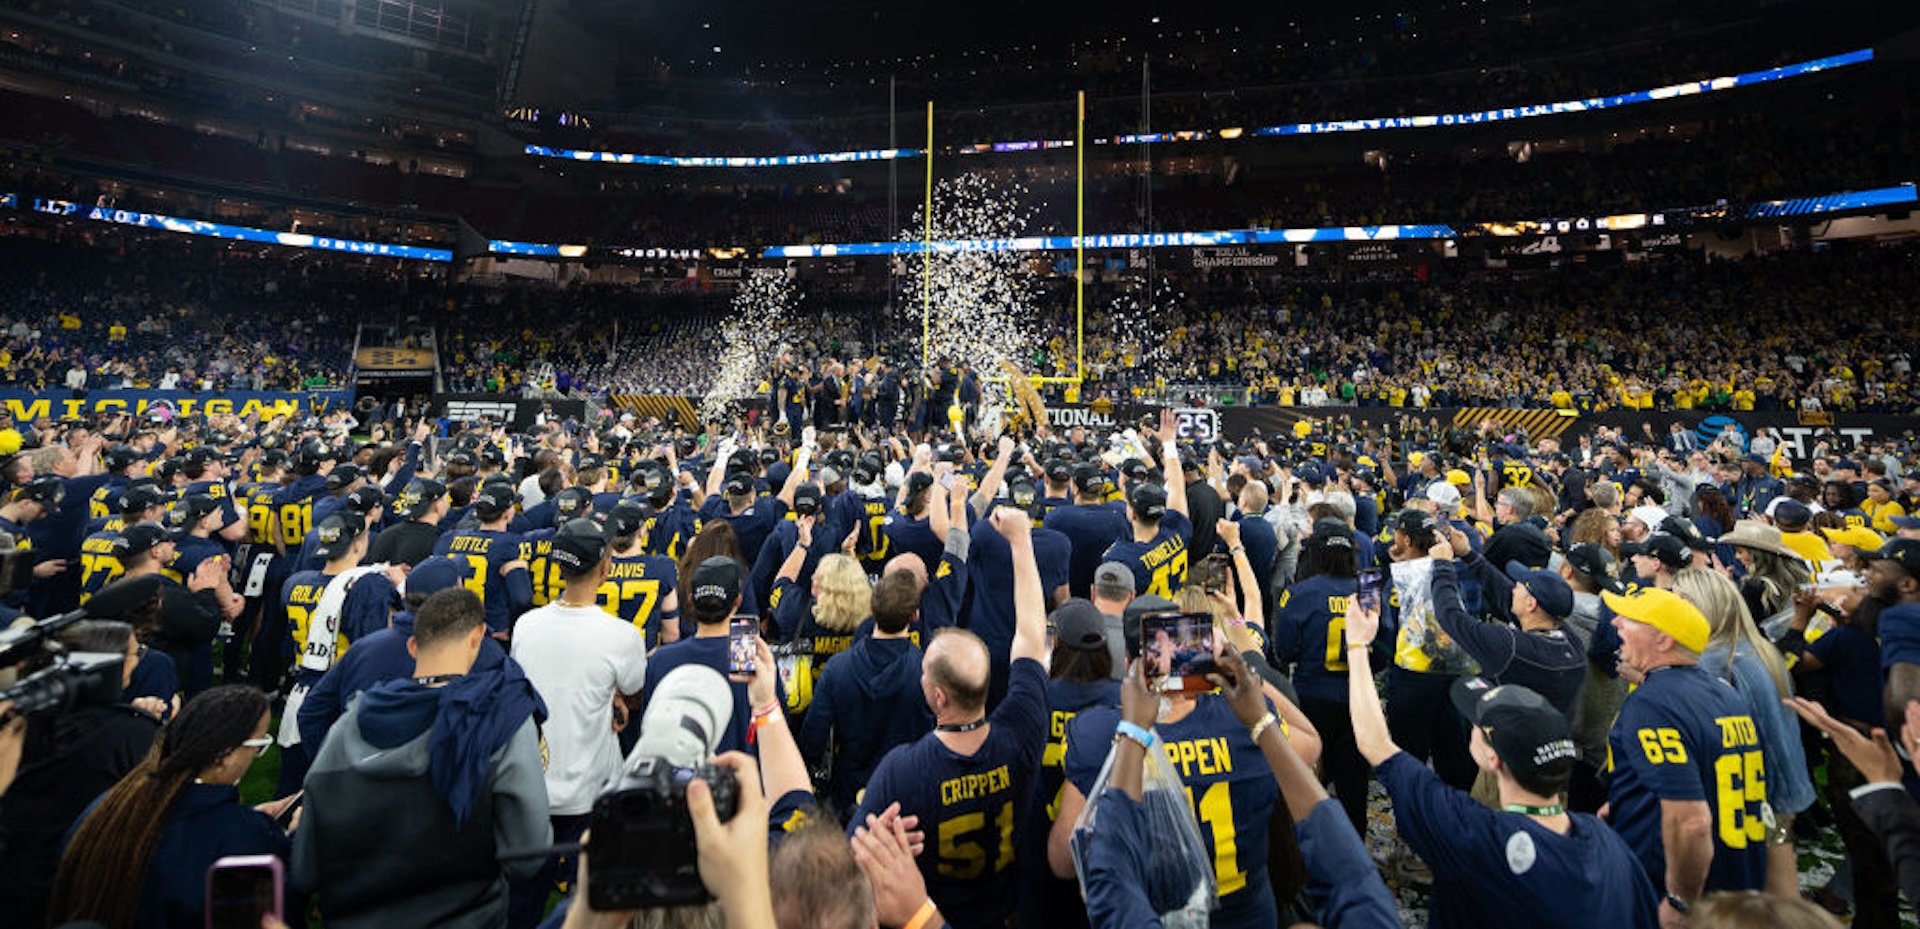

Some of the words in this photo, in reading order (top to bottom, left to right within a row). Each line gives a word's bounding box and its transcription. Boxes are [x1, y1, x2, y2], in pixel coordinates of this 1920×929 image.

[1298, 117, 1411, 133] MICGAN
[1424, 102, 1577, 127] OLVERINE
[447, 401, 517, 423] ESPN
[1045, 408, 1117, 427] TIONAL
[1178, 414, 1210, 437] 25
[1767, 426, 1875, 459] ATT
[209, 484, 226, 498] 91
[281, 503, 313, 545] 81
[451, 536, 493, 552] TUTTLE
[607, 562, 645, 578] DAVIS
[289, 584, 323, 604] ROLA
[1168, 736, 1233, 777] PPEN
[1638, 727, 1688, 764] 65
[940, 764, 1010, 806] CRIPPEN
[1714, 751, 1767, 849] 65
[937, 800, 1016, 880] 51
[1188, 781, 1247, 898] 1
